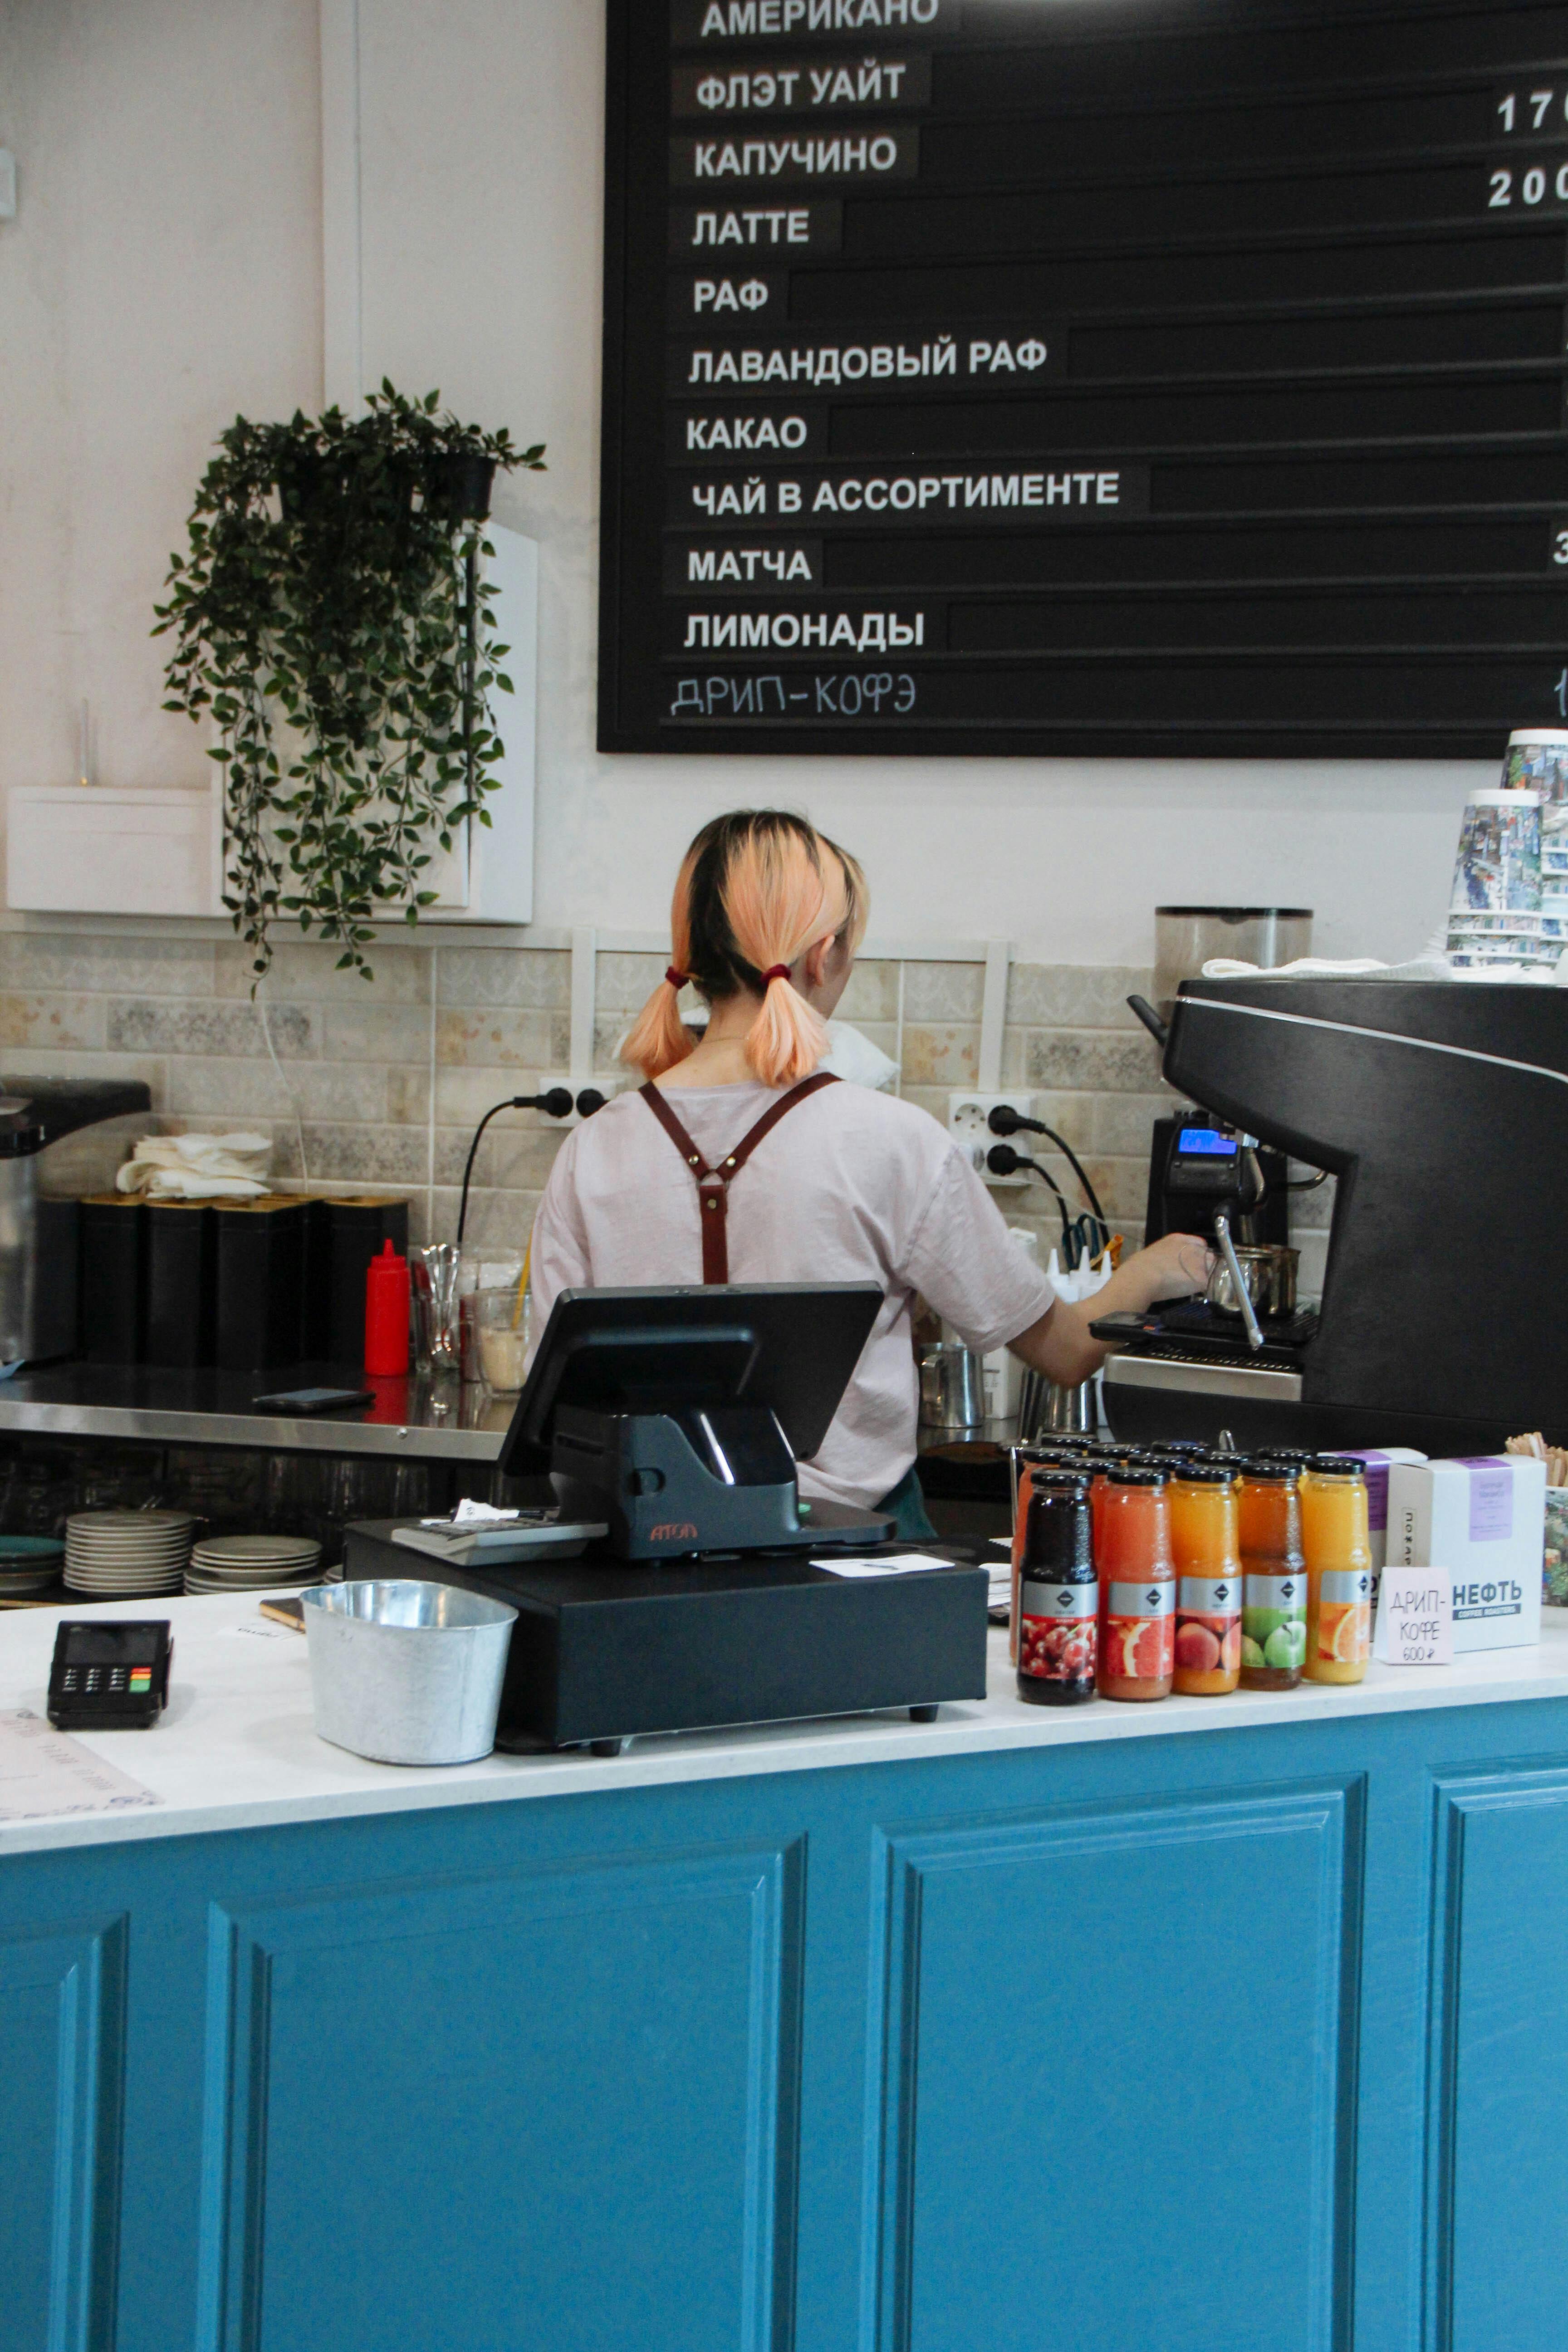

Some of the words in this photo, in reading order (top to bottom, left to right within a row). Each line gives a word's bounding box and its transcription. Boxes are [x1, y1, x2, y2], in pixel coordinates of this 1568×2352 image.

[701, 0, 939, 36] АМЕРИКАНО
[696, 72, 799, 108] ФЛЭТ
[810, 60, 905, 104] УАЙТ
[1498, 92, 1568, 131] 17
[695, 137, 897, 176] КАПУЧИНО
[692, 211, 809, 245] ЛАТТЕ
[694, 280, 768, 312] РАФ
[689, 335, 956, 386] ЛАВАНДОВЫЙ
[970, 339, 1047, 373] РАФ
[687, 417, 807, 449] КАКАО
[692, 477, 765, 515] ЧАЙ
[779, 482, 802, 513] В
[813, 472, 1119, 511] АССОРТИМЕНТЕ
[688, 550, 812, 581] МАТЧА
[684, 613, 924, 652] ЛИМОНАДЫ
[671, 673, 916, 715] ДРИП-КОФЭ
[1453, 1580, 1521, 1606] НЕФТЬ
[1400, 1621, 1440, 1641] КОФЕ
